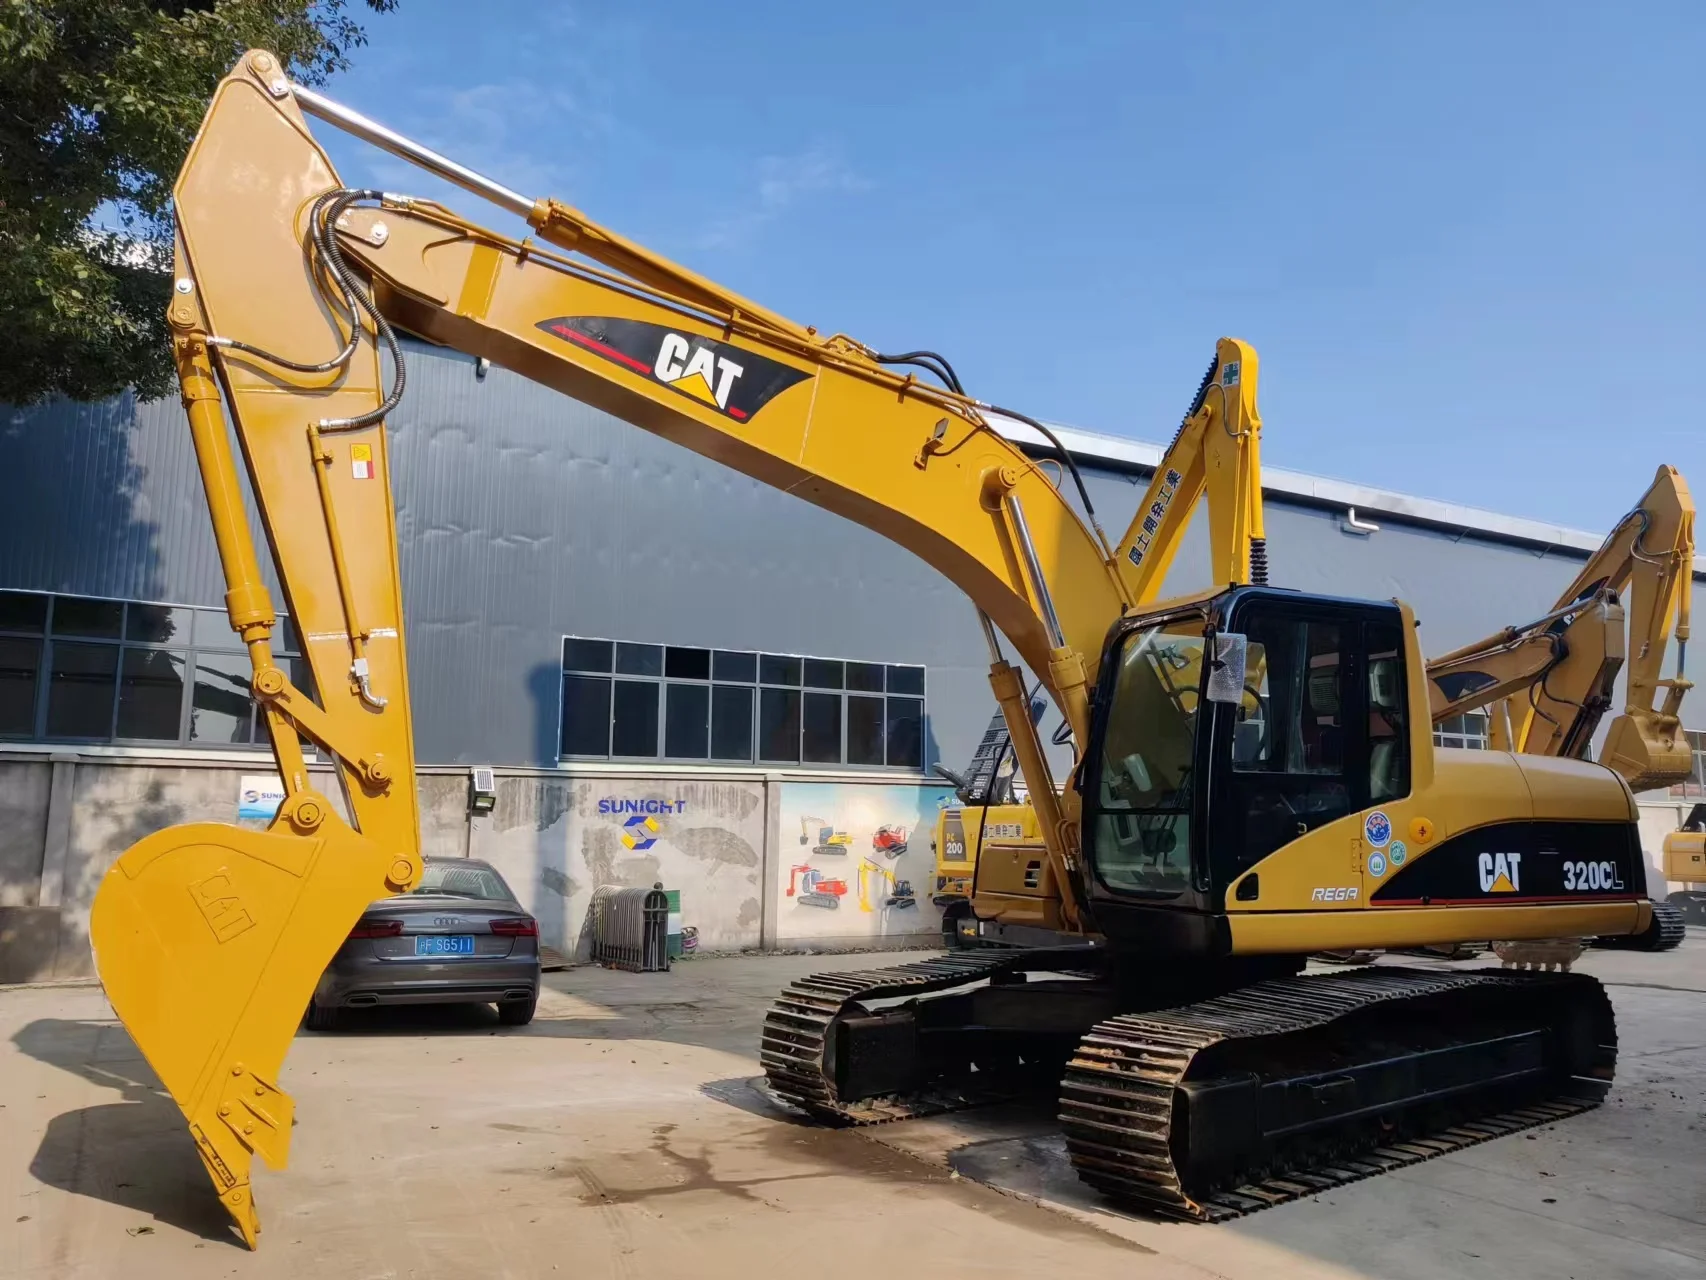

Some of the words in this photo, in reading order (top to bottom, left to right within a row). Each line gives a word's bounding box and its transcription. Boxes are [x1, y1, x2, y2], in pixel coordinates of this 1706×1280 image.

[654, 333, 744, 410] CAT
[598, 799, 686, 814] SUNIGHT
[946, 833, 955, 842] PC
[946, 843, 963, 854] 200
[1478, 852, 1522, 893] CAT
[1563, 860, 1625, 891] 320CL
[1311, 887, 1359, 901] REGA
